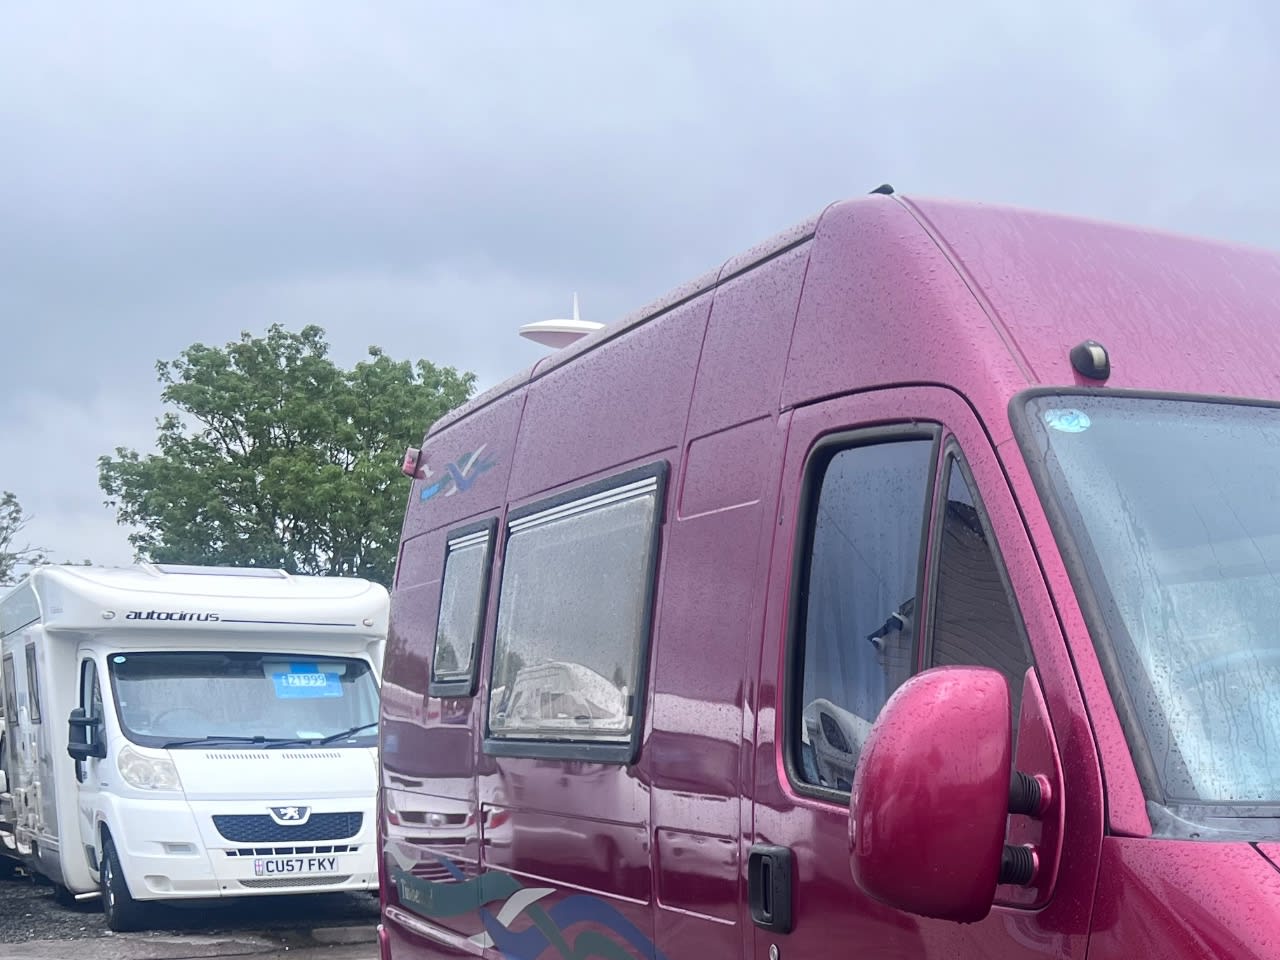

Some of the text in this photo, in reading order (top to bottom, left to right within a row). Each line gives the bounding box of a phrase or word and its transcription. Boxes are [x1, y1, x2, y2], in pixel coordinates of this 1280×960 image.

[125, 610, 220, 622] autocirrus
[265, 857, 336, 873] CU57 FKY
